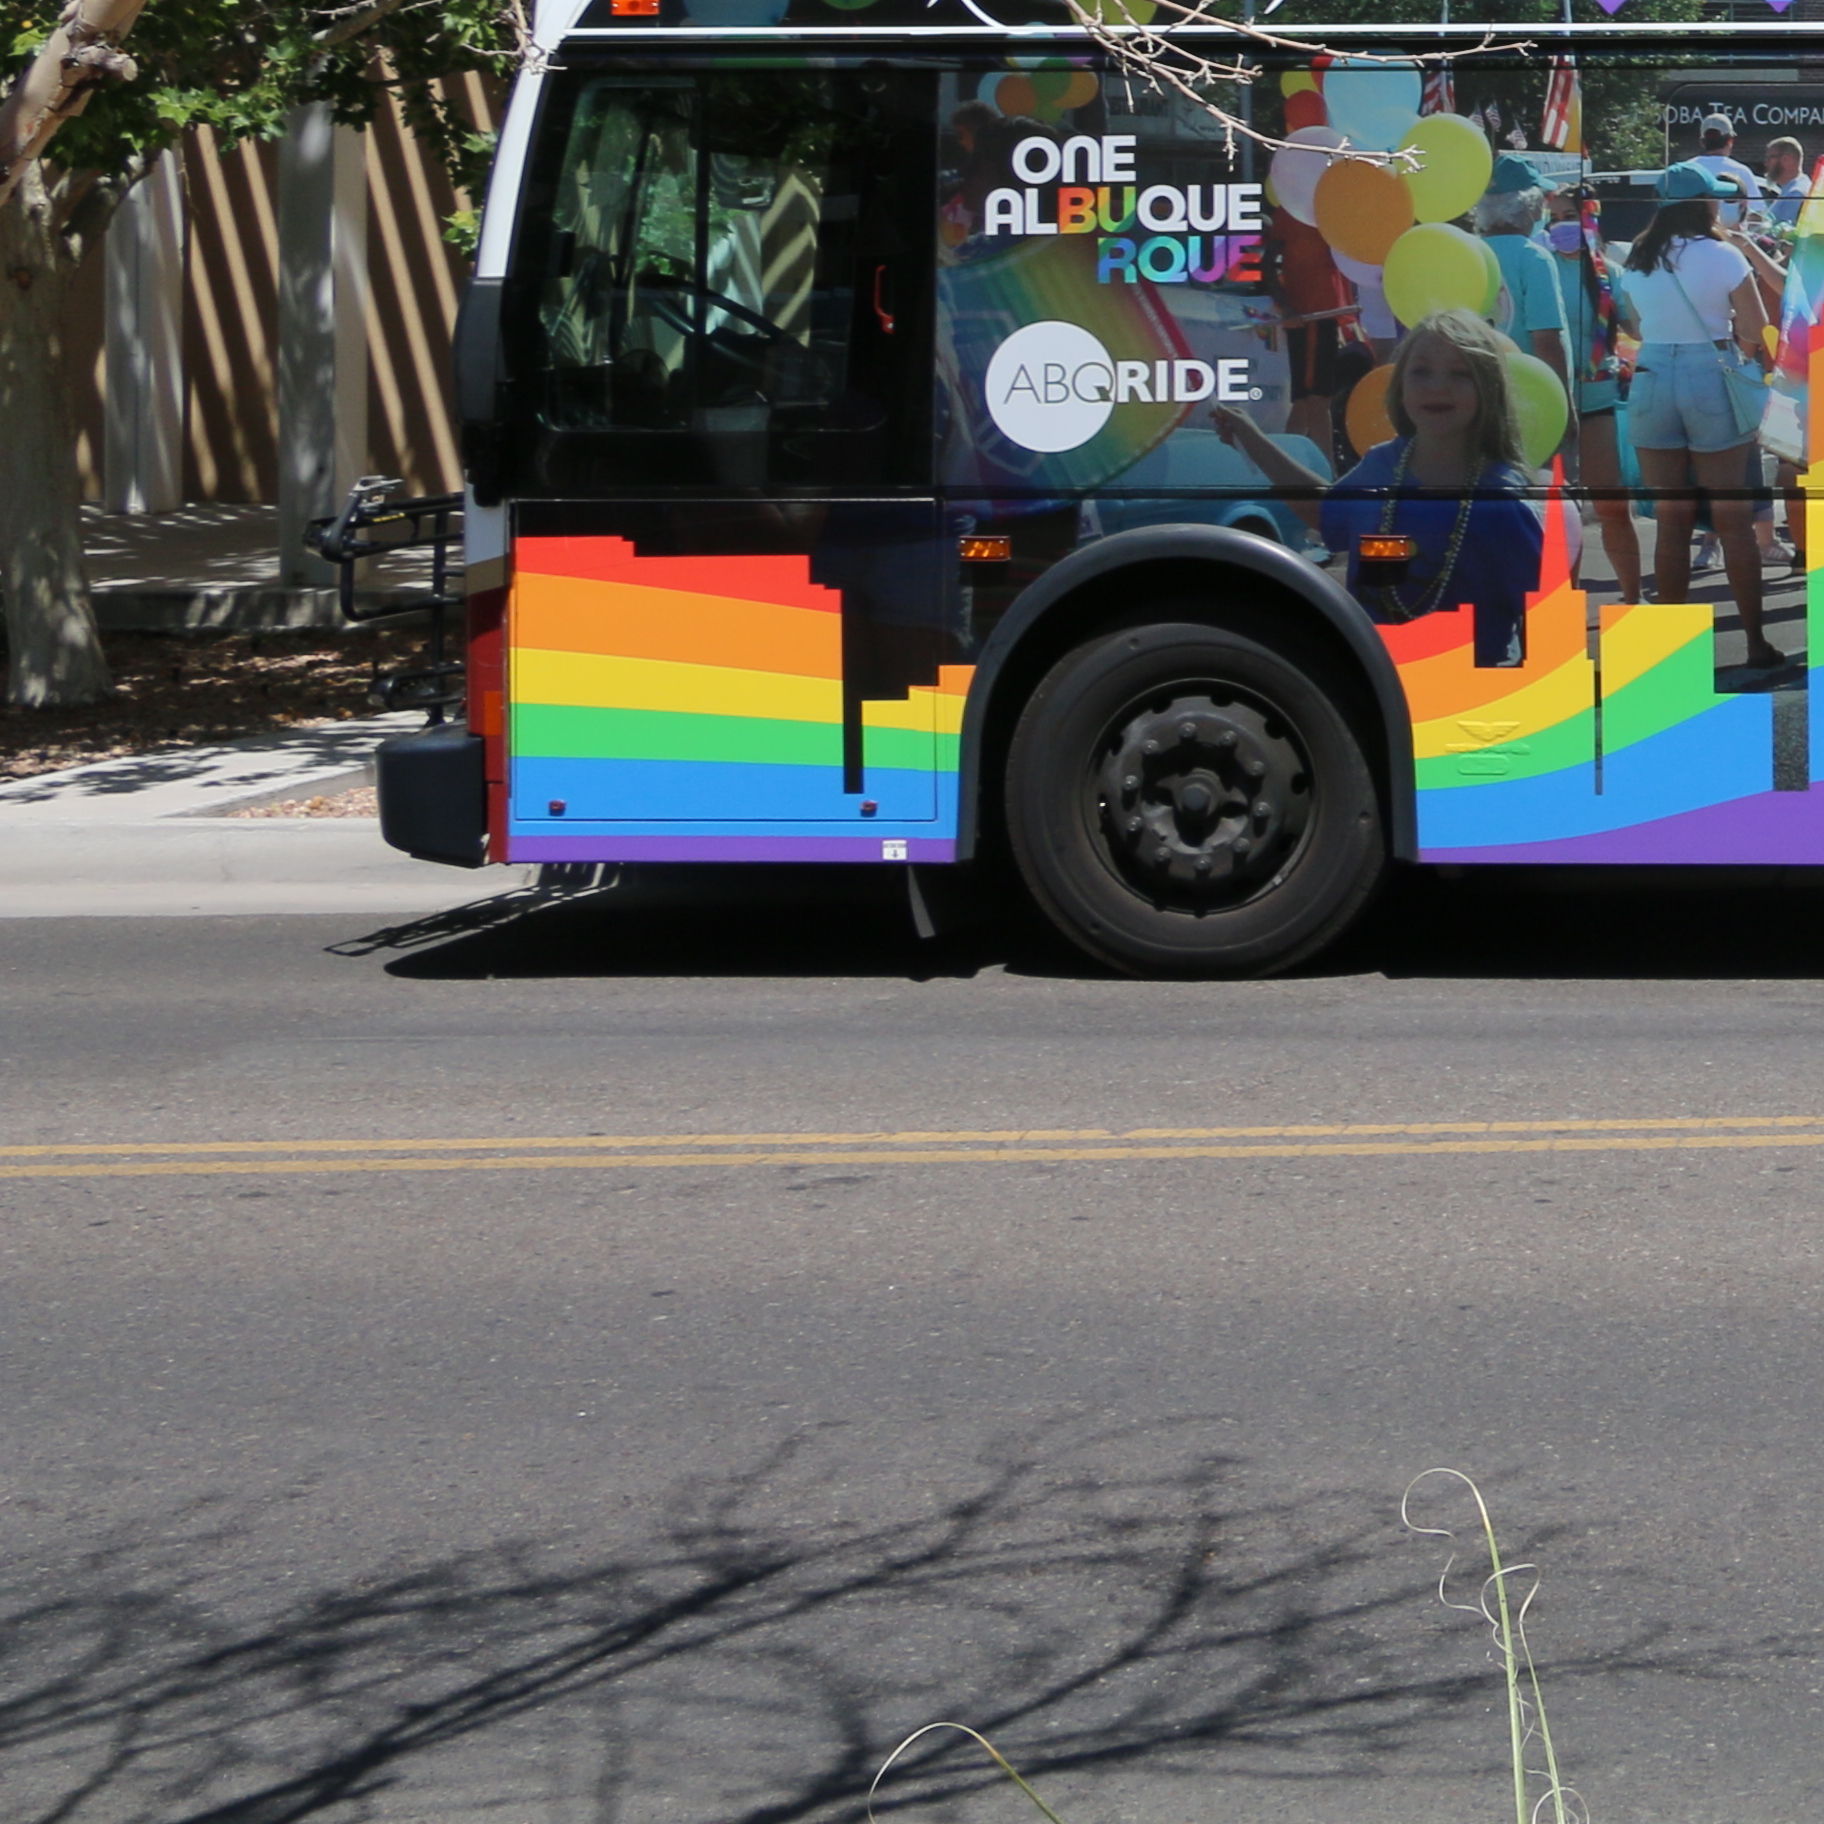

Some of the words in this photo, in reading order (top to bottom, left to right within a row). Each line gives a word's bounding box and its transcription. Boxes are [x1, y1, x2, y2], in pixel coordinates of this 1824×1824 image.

[1012, 135, 1136, 184] ONE
[985, 184, 1263, 236] ALBUQUE
[1097, 235, 1263, 284] RQUE
